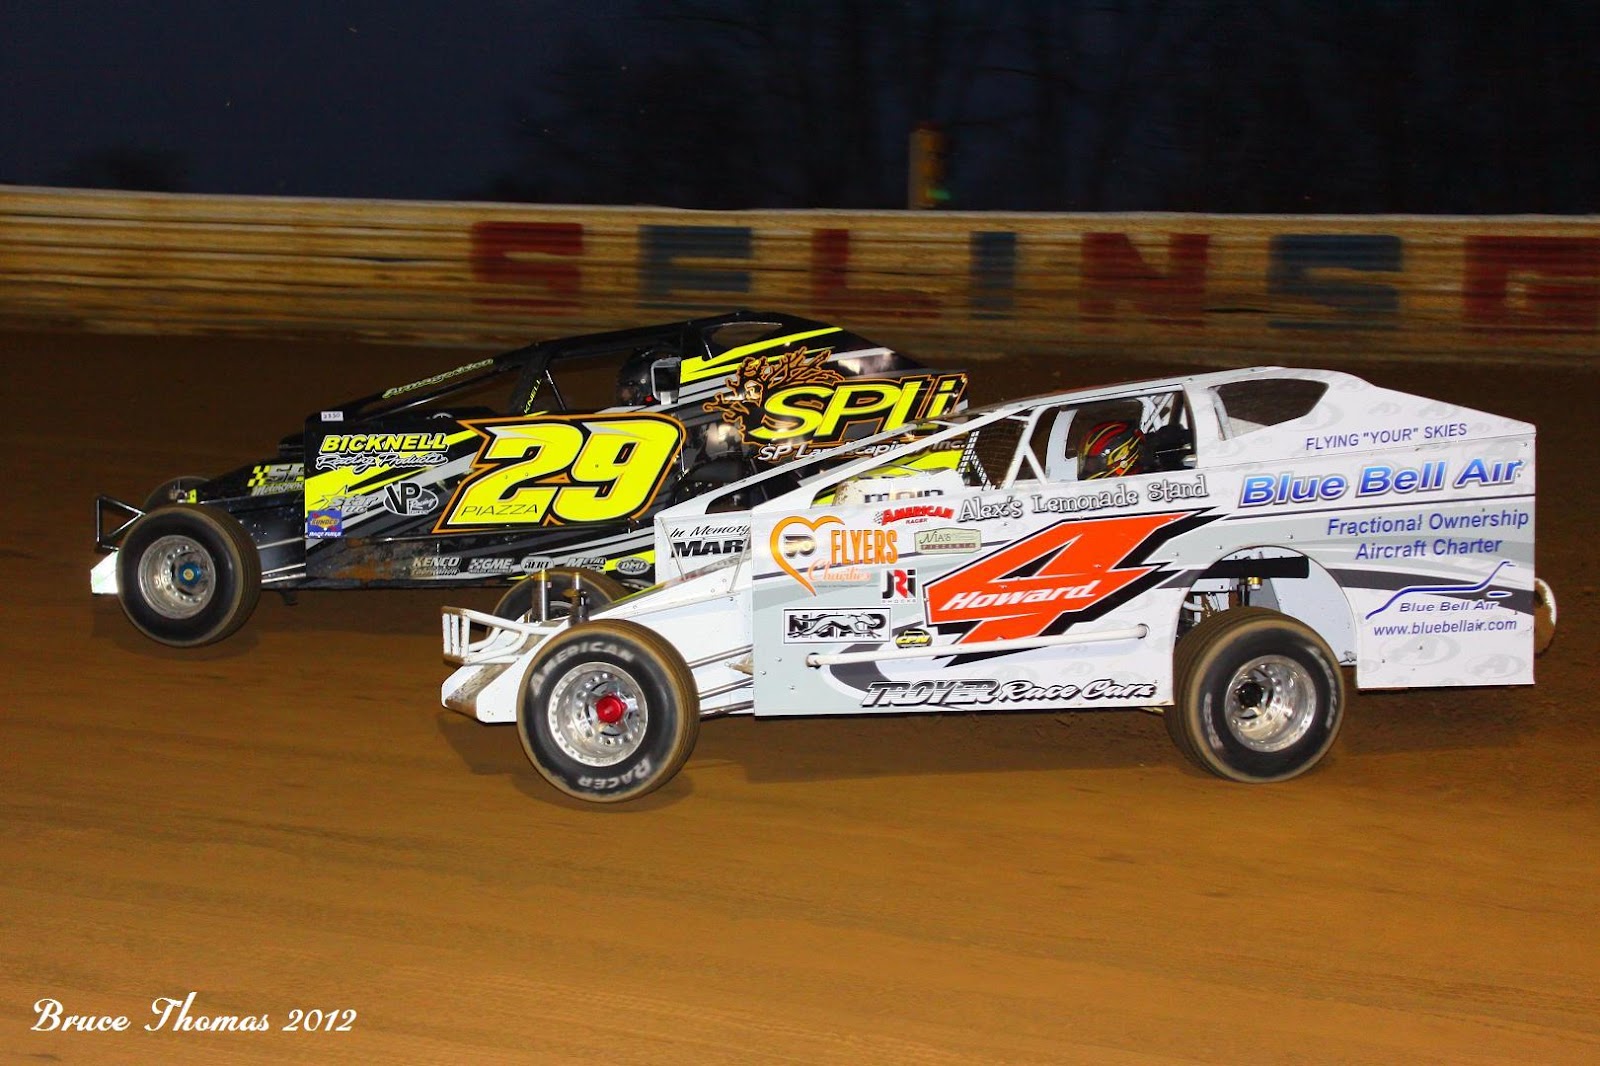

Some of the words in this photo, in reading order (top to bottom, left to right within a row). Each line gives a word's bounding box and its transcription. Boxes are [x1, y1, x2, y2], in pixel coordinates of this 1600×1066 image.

[319, 432, 449, 453] BICKNELL
[1306, 434, 1359, 450] FLYING
[1363, 428, 1419, 446] "YOUR"
[1424, 423, 1468, 439] SKIES
[316, 452, 377, 474] Racing
[378, 451, 449, 468] Products
[758, 443, 792, 462] SP
[445, 414, 684, 526] 29
[1238, 472, 1350, 508] Blue
[1356, 460, 1448, 498] Bell
[1452, 457, 1525, 487] Air
[384, 481, 422, 515] VP
[460, 503, 539, 518] PIAZZA
[958, 495, 1023, 524] Alex's
[1032, 484, 1139, 514] Lemonade
[1147, 475, 1209, 502] Stand
[881, 505, 955, 526] AMERICAN
[1327, 514, 1423, 536] Fractional
[1429, 508, 1529, 532] Ownership
[670, 527, 685, 538] In
[689, 525, 750, 537] Memory
[830, 529, 899, 566] FLYERS
[1355, 540, 1426, 561] Aircraft
[1432, 537, 1503, 557] Charter
[412, 557, 460, 568] KENCO
[923, 510, 1193, 646] 4
[937, 580, 1103, 612] Howard
[1400, 603, 1434, 613] Blue
[1440, 602, 1469, 612] Bell
[1473, 601, 1498, 611] Air
[1374, 619, 1517, 636] www.bluebellair.com
[531, 641, 635, 696] AMERICAN
[860, 679, 1000, 707] TROYER
[998, 679, 1082, 703] Race
[1080, 678, 1157, 700] Cars
[577, 756, 652, 790] RACER
